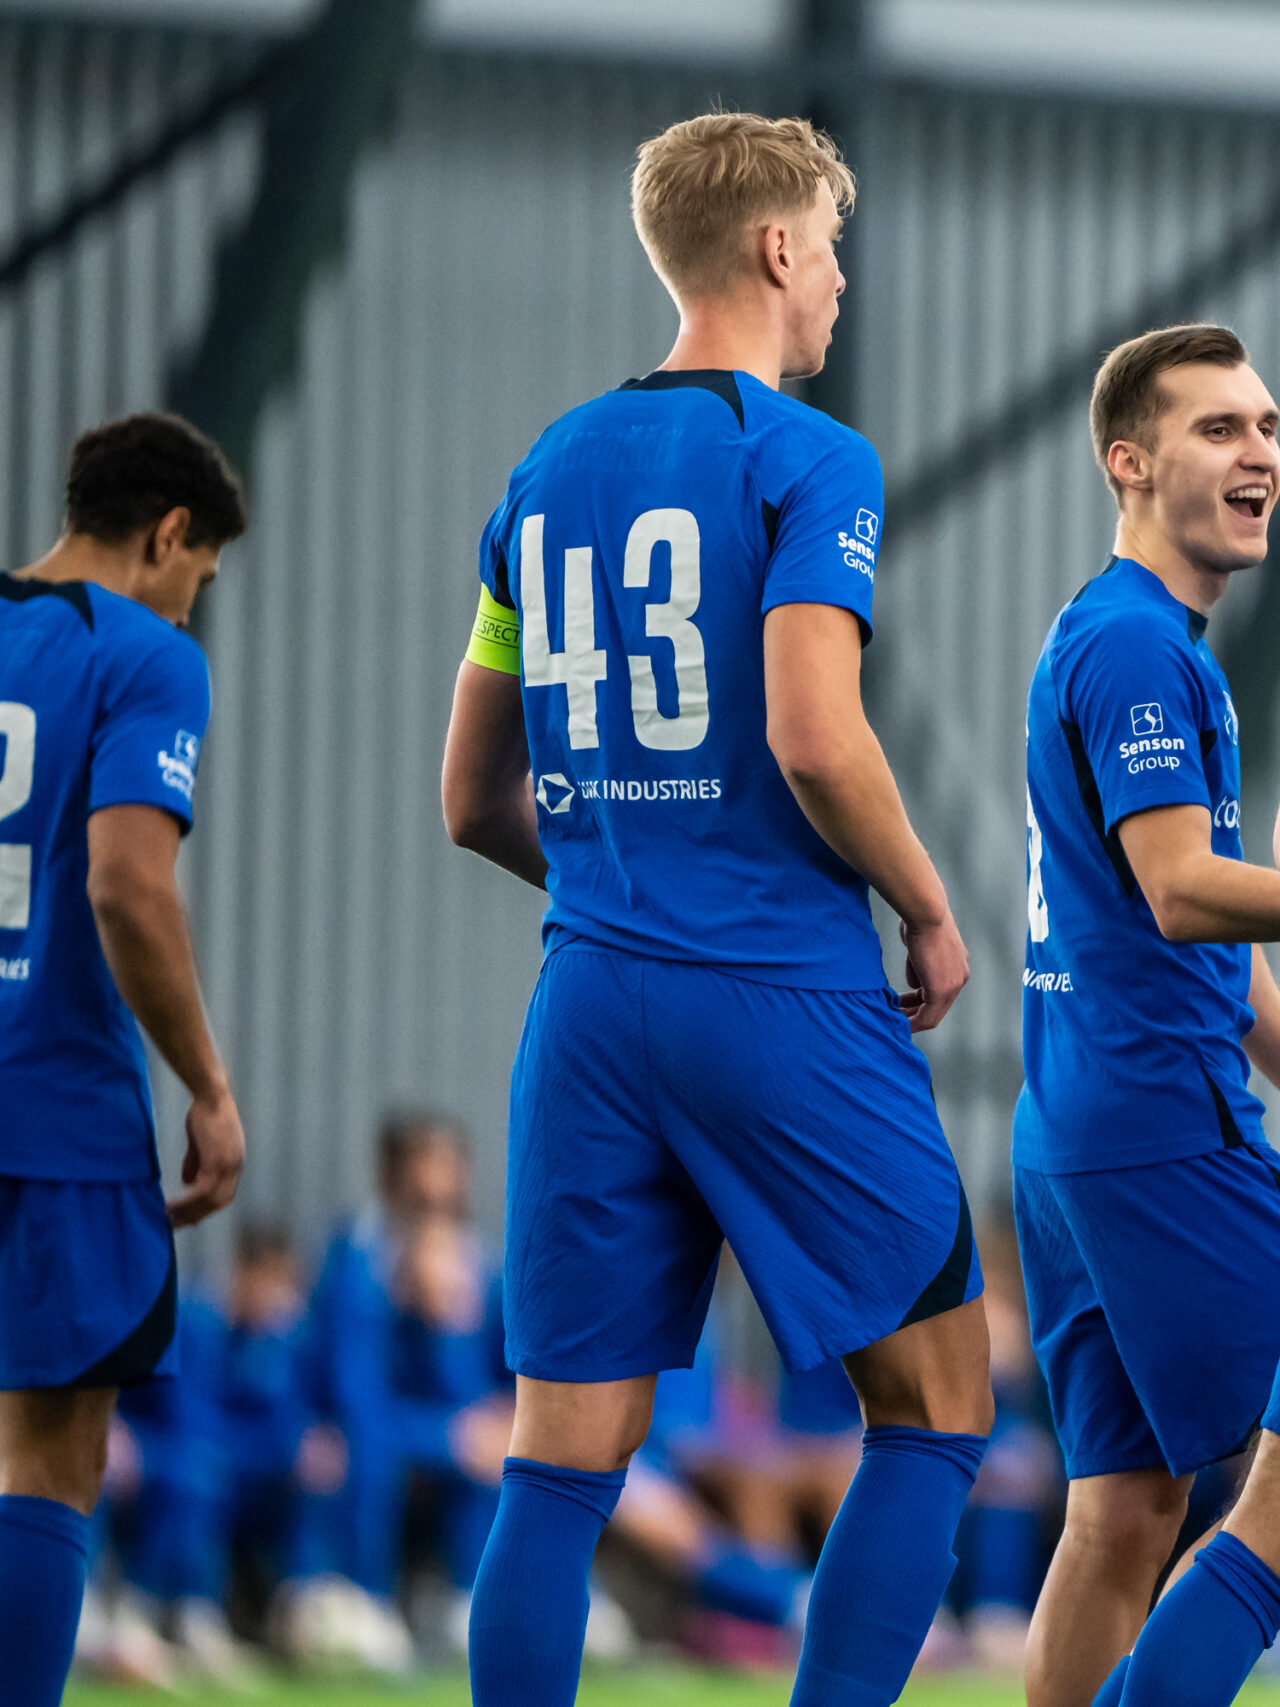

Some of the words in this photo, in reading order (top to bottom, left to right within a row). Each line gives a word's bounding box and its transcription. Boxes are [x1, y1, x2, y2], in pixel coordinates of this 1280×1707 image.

[521, 508, 709, 751] 43
[1119, 738, 1185, 758] Senson
[1128, 756, 1180, 774] Group
[603, 779, 721, 800] INDUSTRIES
